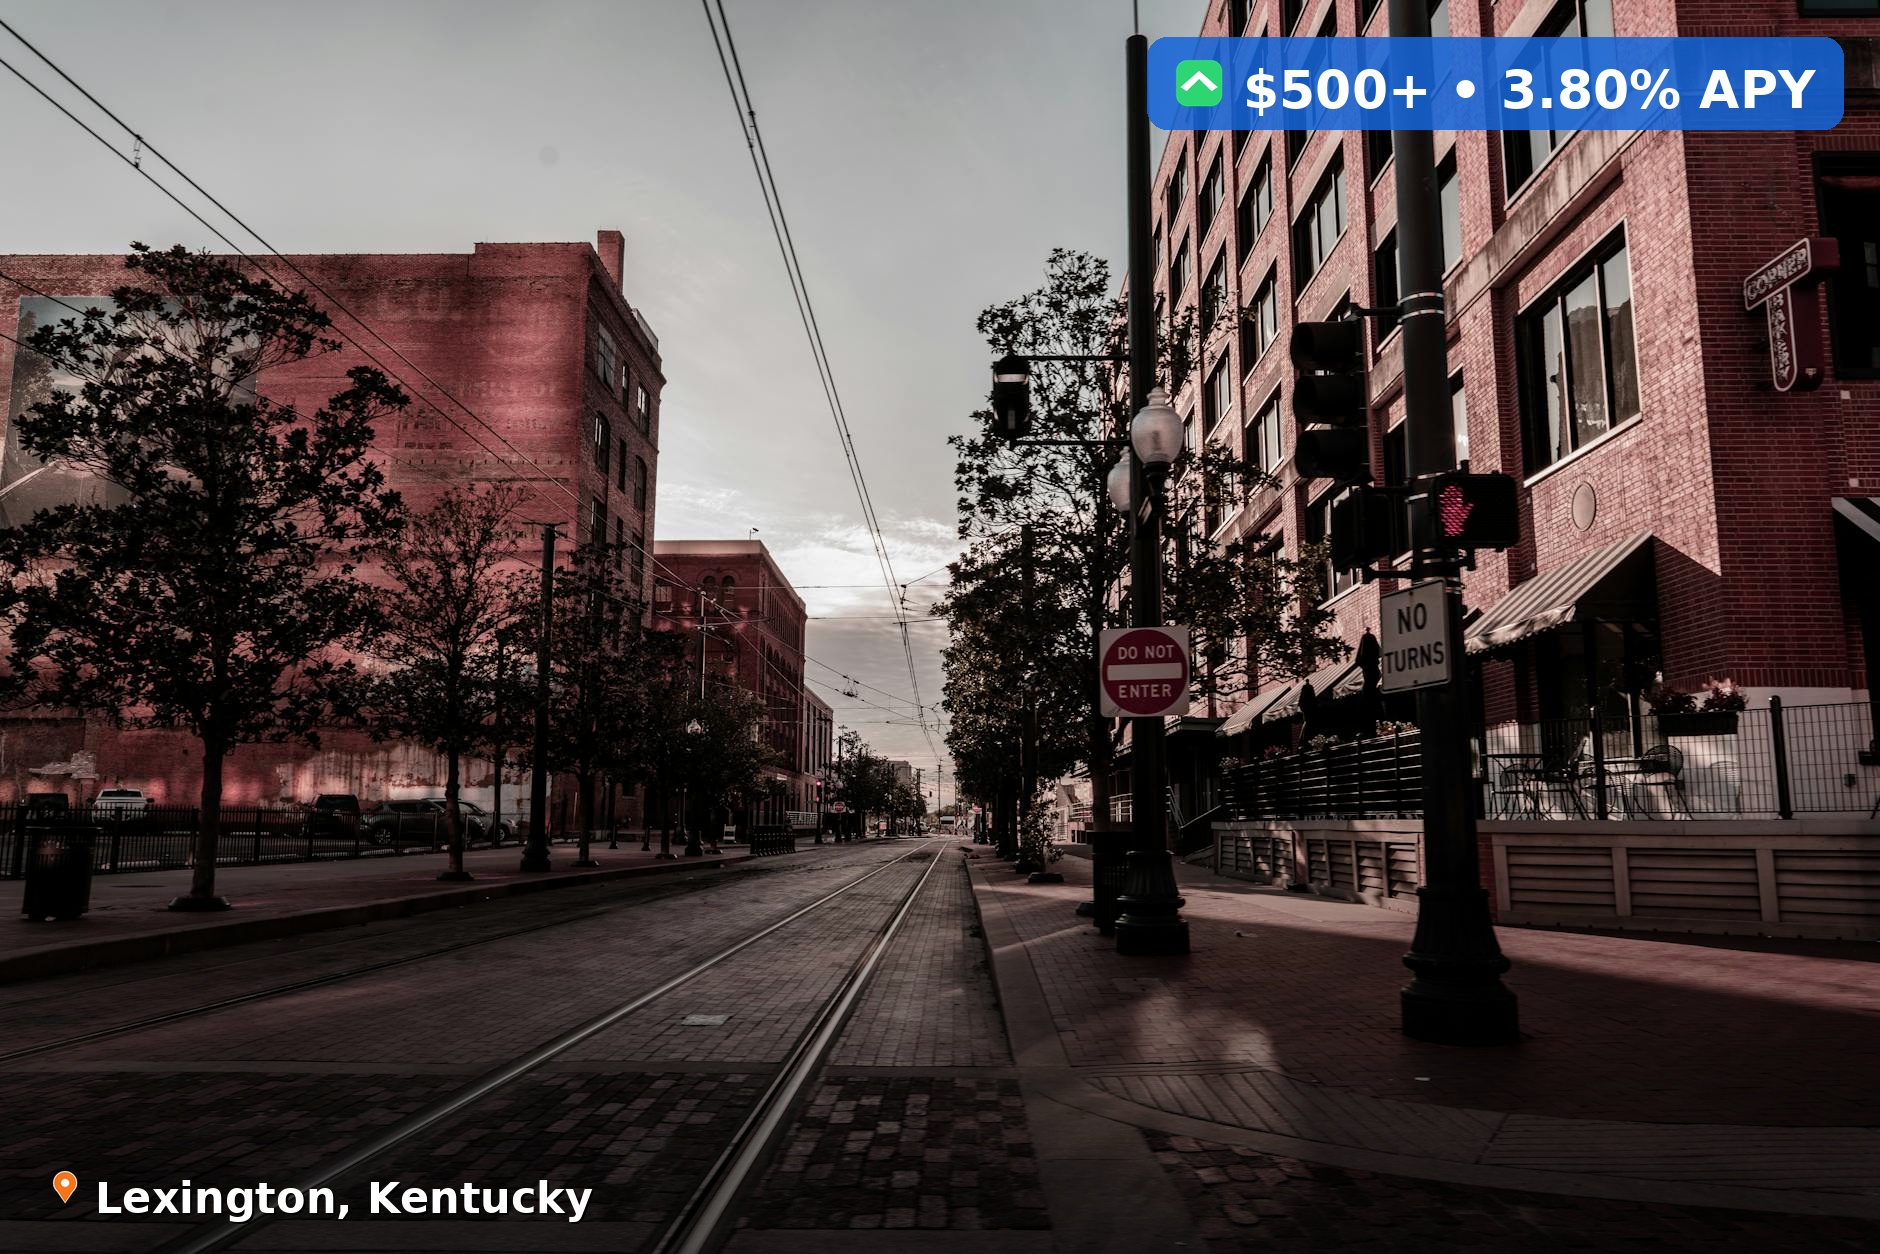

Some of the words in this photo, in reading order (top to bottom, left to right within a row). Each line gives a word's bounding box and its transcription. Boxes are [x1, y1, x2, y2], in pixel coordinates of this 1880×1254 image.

[1746, 247, 1807, 301] CORNER
[1397, 602, 1428, 635] NO
[1117, 645, 1139, 660] DO
[1144, 644, 1175, 660] NOT
[1384, 641, 1445, 674] TURNS
[1117, 683, 1173, 699] ENTER
